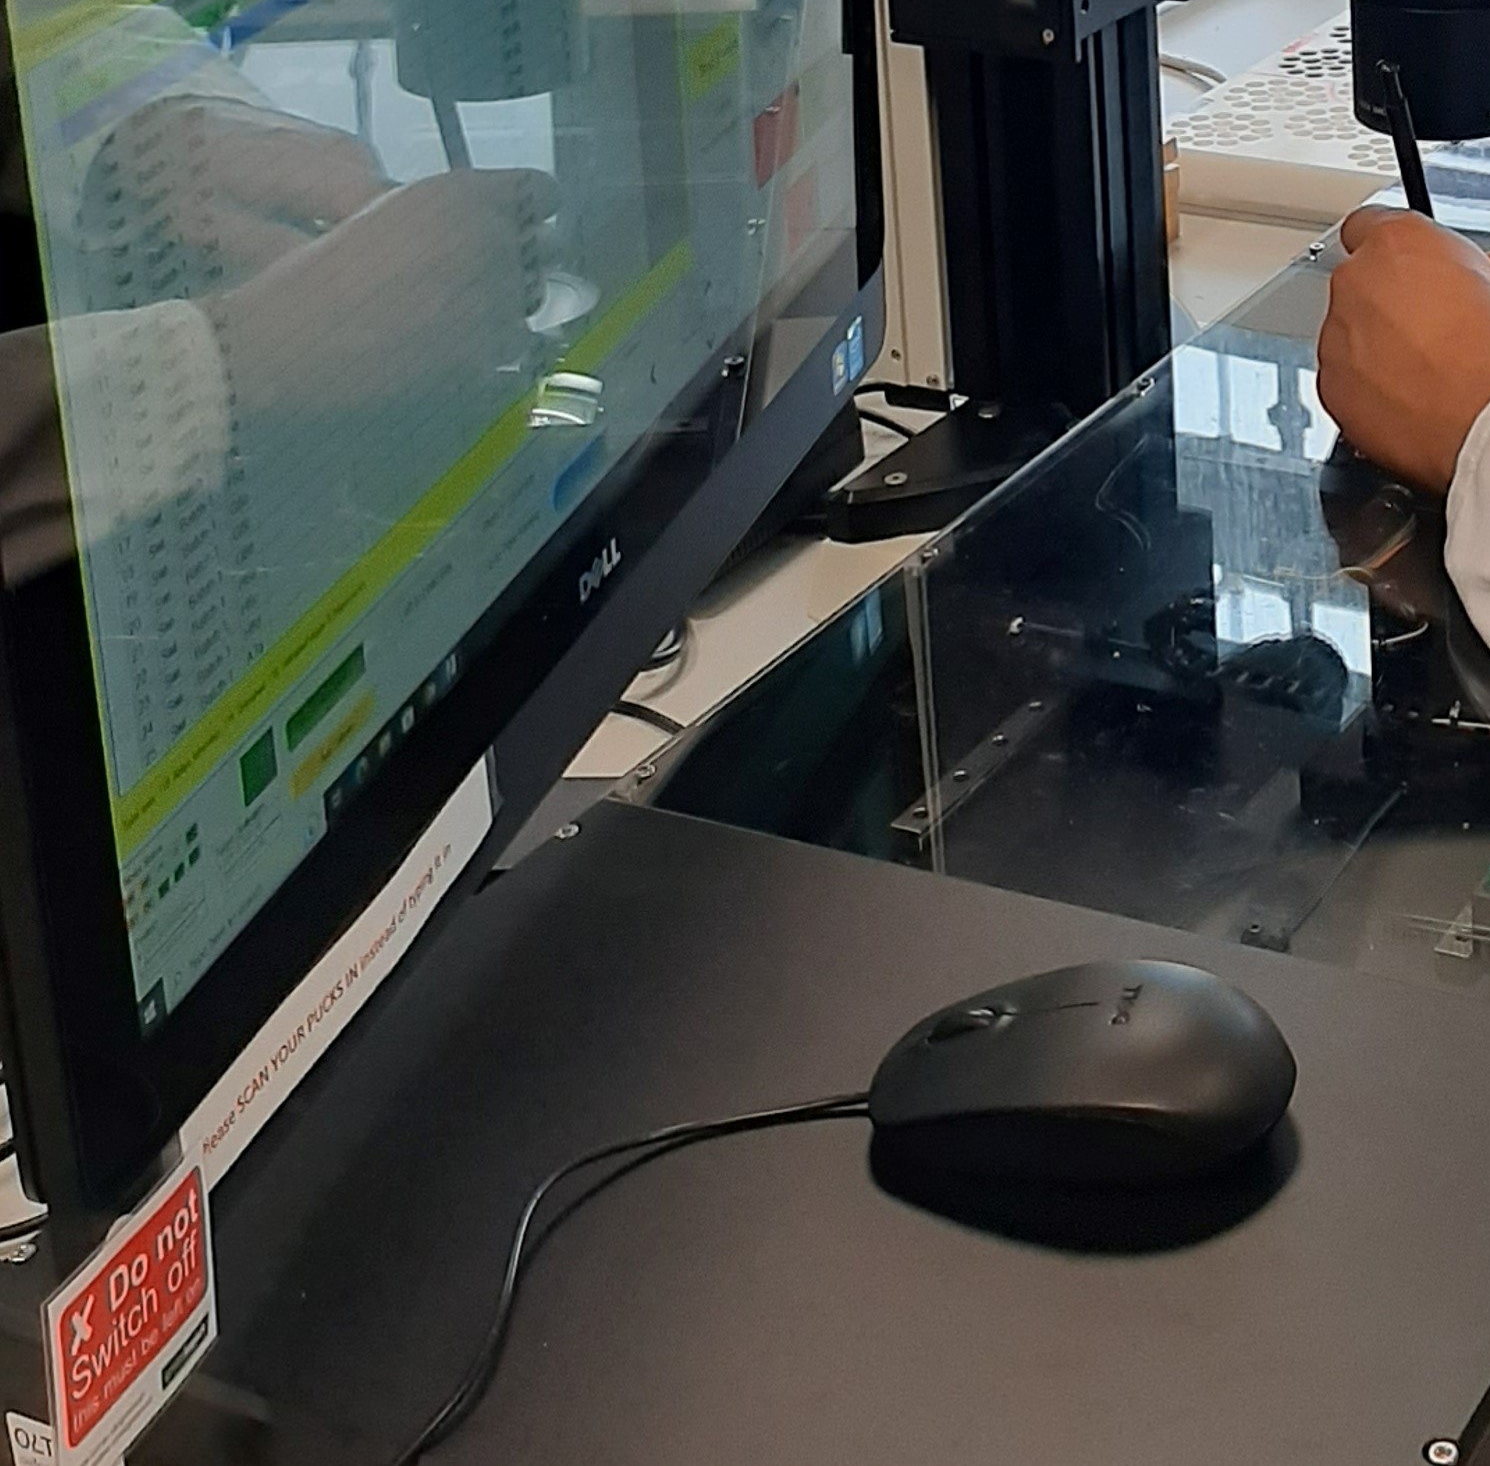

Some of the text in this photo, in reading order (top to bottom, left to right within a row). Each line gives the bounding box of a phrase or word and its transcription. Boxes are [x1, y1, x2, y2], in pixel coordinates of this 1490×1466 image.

[579, 536, 621, 606] DELL
[236, 1065, 269, 1113] SCAN
[270, 1025, 305, 1072] YOUR
[306, 980, 344, 1032] PUCKS
[345, 964, 359, 988] IN
[71, 1286, 158, 1401] Switch
[167, 1228, 198, 1293] off
[108, 1188, 199, 1313] Do not
